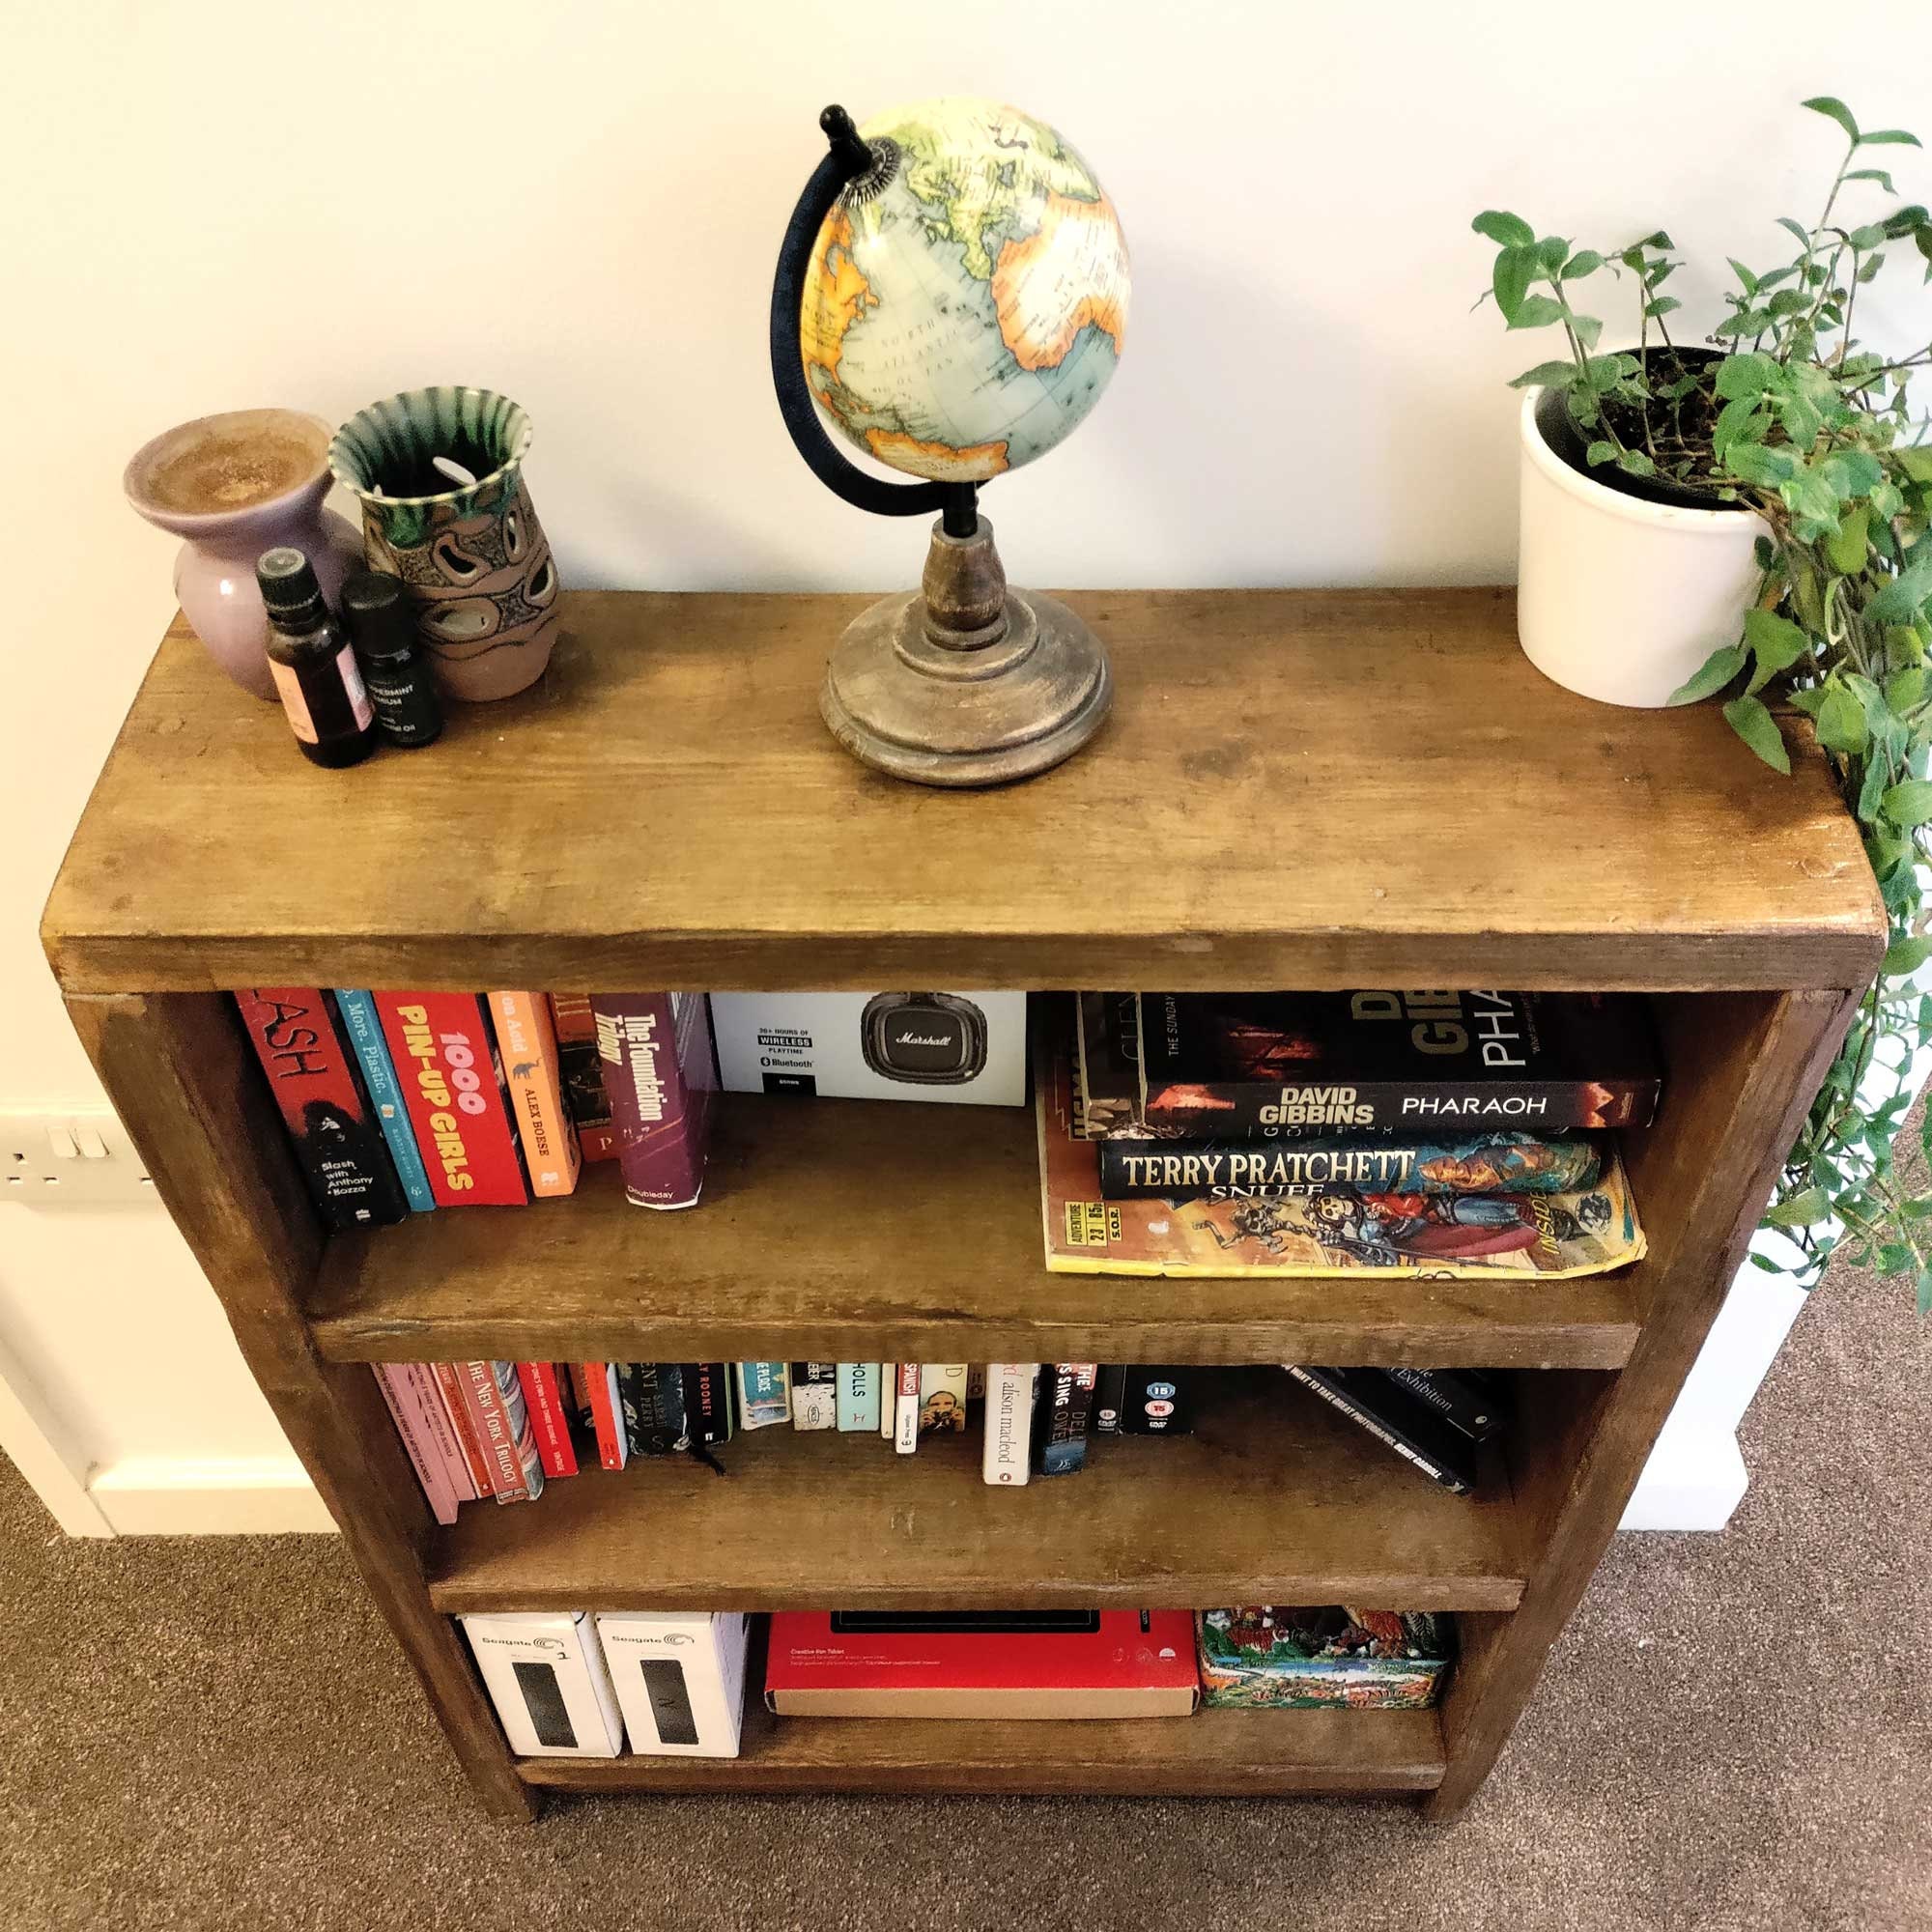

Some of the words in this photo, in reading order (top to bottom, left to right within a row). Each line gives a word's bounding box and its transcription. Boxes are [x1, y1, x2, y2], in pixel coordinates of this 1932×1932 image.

[595, 1011, 626, 1066] Trilogy
[624, 1012, 657, 1042] The
[760, 1037, 810, 1046] WIRELESS
[896, 1032, 951, 1046] Marshall
[1167, 1036, 1179, 1057] THE
[439, 1031, 487, 1116] 1000
[772, 1058, 812, 1068] Bluetooth
[629, 1041, 668, 1122] Foundation
[1281, 1087, 1357, 1105] DAVID
[397, 1004, 452, 1108] PIN-UP
[429, 1112, 475, 1191] GIRLS
[526, 1089, 542, 1119] ALEX
[1402, 1096, 1547, 1115] PHARAOH
[1259, 1104, 1375, 1124] GIBBINS
[533, 1120, 550, 1157] BOESE
[1122, 1153, 1223, 1187] TERRY
[1228, 1150, 1416, 1184] PRATCHETT
[627, 1184, 674, 1200] Doubleday
[1069, 1204, 1083, 1243] ADVENTURE
[1089, 1228, 1105, 1241] 23
[468, 1360, 485, 1383] THE
[903, 1363, 918, 1395] SPANISH
[1076, 1363, 1094, 1387] THE
[1308, 1379, 1319, 1390] TO
[474, 1380, 495, 1408] NEW
[699, 1377, 711, 1417] ROONEY
[1001, 1381, 1020, 1415] alison
[1055, 1376, 1072, 1406] SING
[1154, 1387, 1169, 1395] 15
[1397, 1368, 1453, 1412] Exhibition
[484, 1409, 503, 1442] YORK
[998, 1418, 1017, 1464] macleod
[495, 1441, 518, 1484] TRILOGY
